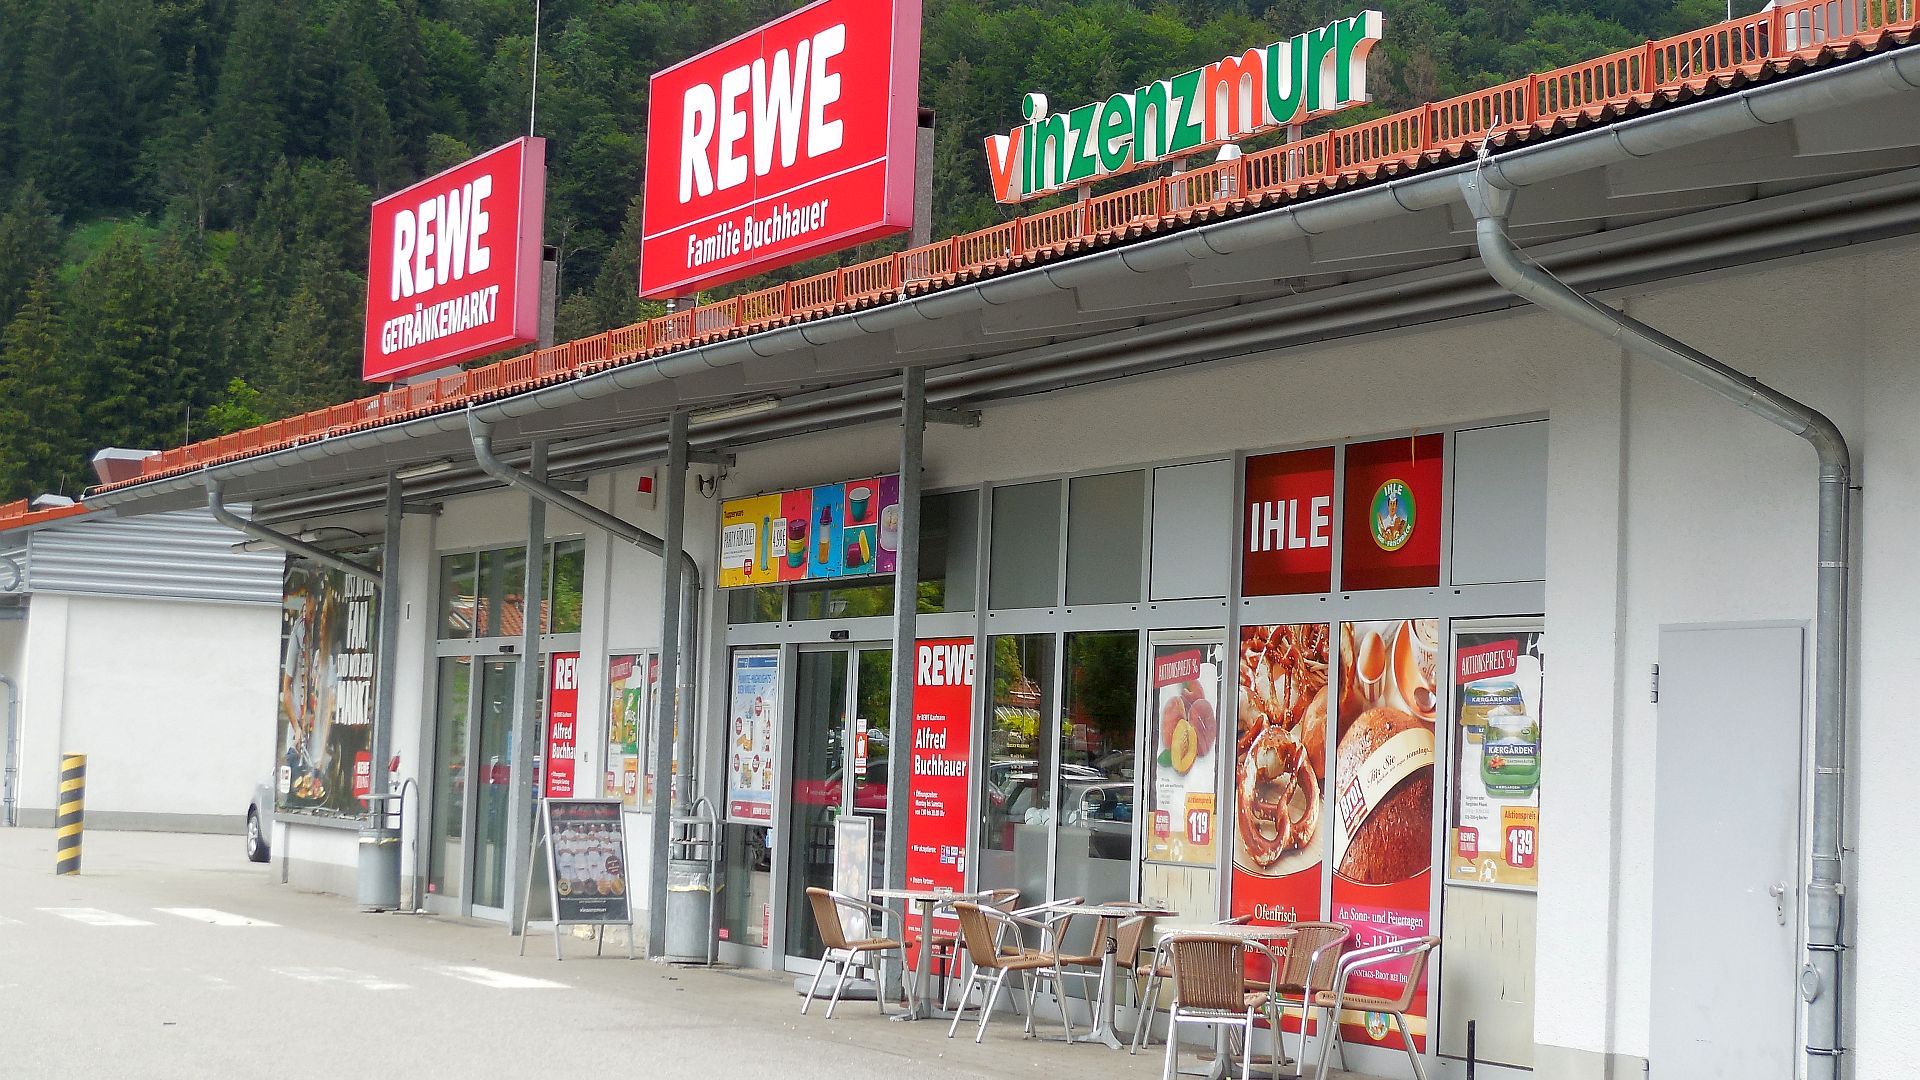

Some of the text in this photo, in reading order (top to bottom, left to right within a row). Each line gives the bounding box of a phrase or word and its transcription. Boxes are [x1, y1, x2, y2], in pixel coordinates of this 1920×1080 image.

[679, 23, 845, 204] REWE
[984, 10, 1382, 203] vinzenzmurr
[391, 174, 492, 301] REWE
[687, 199, 828, 268] Familie Buchhauer
[382, 285, 499, 354] GETRÄNKEMARKT
[1384, 483, 1403, 496] IHLE
[724, 509, 744, 519] Tupperware
[1250, 496, 1330, 552] IHLE
[723, 530, 736, 548] PARTY
[555, 657, 580, 690] REW
[917, 644, 974, 686] REWE
[1158, 659, 1191, 681] AKTIONSPREIS
[1461, 650, 1506, 677] AKTIONSPREIS
[553, 723, 573, 740] Alfred
[915, 727, 947, 750] Alfred
[1488, 744, 1533, 755] KÆRGÅRDEN
[914, 754, 967, 777] Buchhauer
[1504, 810, 1536, 822] Aktionspreis
[1461, 832, 1476, 841] REWE
[1254, 903, 1297, 923] Ofenfrisch
[1339, 907, 1424, 931] An Sonn- und Feiertagen
[1355, 933, 1361, 948] 8
